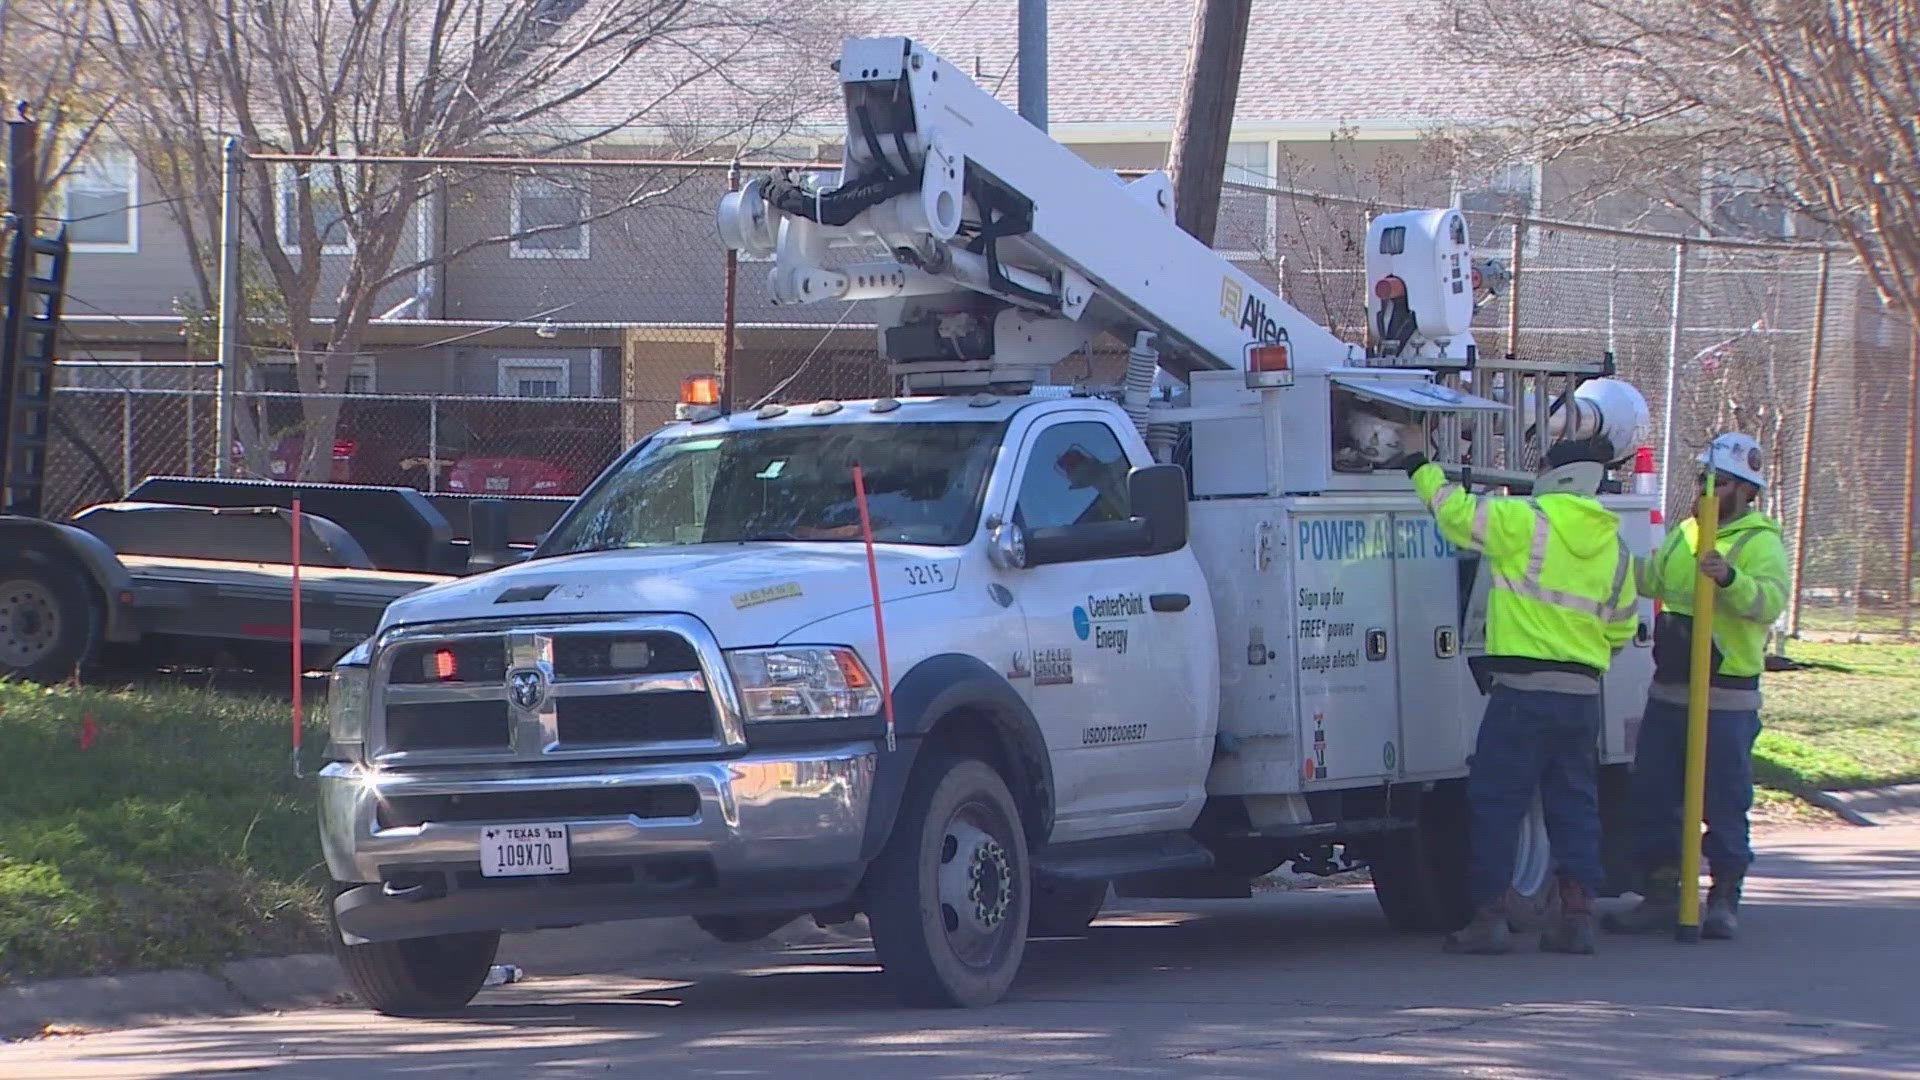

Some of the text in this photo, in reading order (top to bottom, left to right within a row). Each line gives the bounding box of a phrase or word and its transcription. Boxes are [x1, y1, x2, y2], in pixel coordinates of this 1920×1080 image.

[1299, 520, 1366, 560] POWER
[1373, 519, 1428, 559] ALERT
[904, 564, 944, 585] 3215
[1299, 586, 1344, 611] Sign up for
[1095, 626, 1128, 654] Energy
[1327, 623, 1354, 642] power
[1301, 648, 1359, 674] outage alerts!
[1083, 723, 1147, 744] USDOT2006527
[506, 828, 541, 839] TEXAS
[497, 843, 552, 867] 109X70
